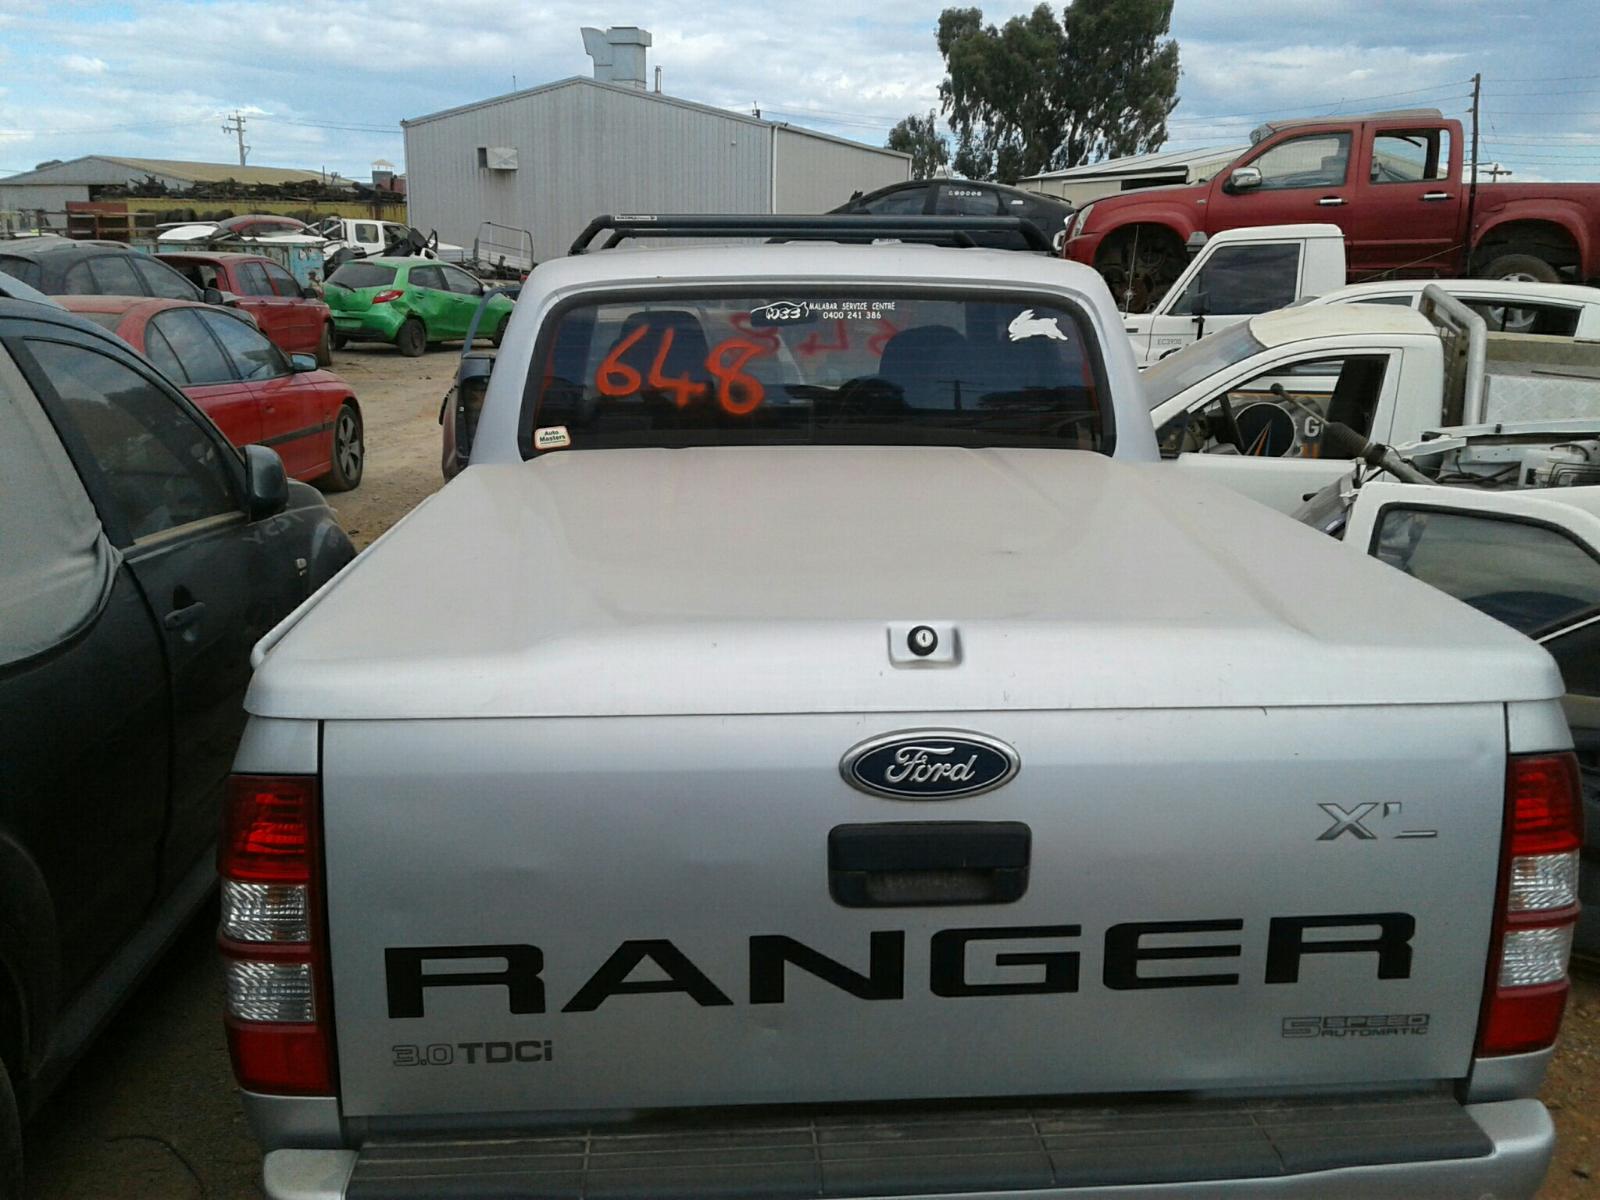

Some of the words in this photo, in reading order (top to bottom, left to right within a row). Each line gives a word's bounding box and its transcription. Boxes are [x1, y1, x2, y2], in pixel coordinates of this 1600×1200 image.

[808, 302, 838, 310] MALABAR
[842, 302, 868, 310] SERVICE
[871, 302, 896, 310] CENTRE
[822, 311, 844, 320] 0400
[847, 311, 862, 320] 241
[866, 311, 882, 320] 386
[595, 324, 765, 416] 648
[539, 434, 566, 442] Masters
[885, 746, 978, 783] Ford
[385, 912, 1416, 1018] RANGER
[1323, 1013, 1430, 1028] SPEED
[1321, 1026, 1428, 1037] AUTOMATIC
[391, 1043, 454, 1067] 3.0
[457, 1039, 553, 1064] TDCi
